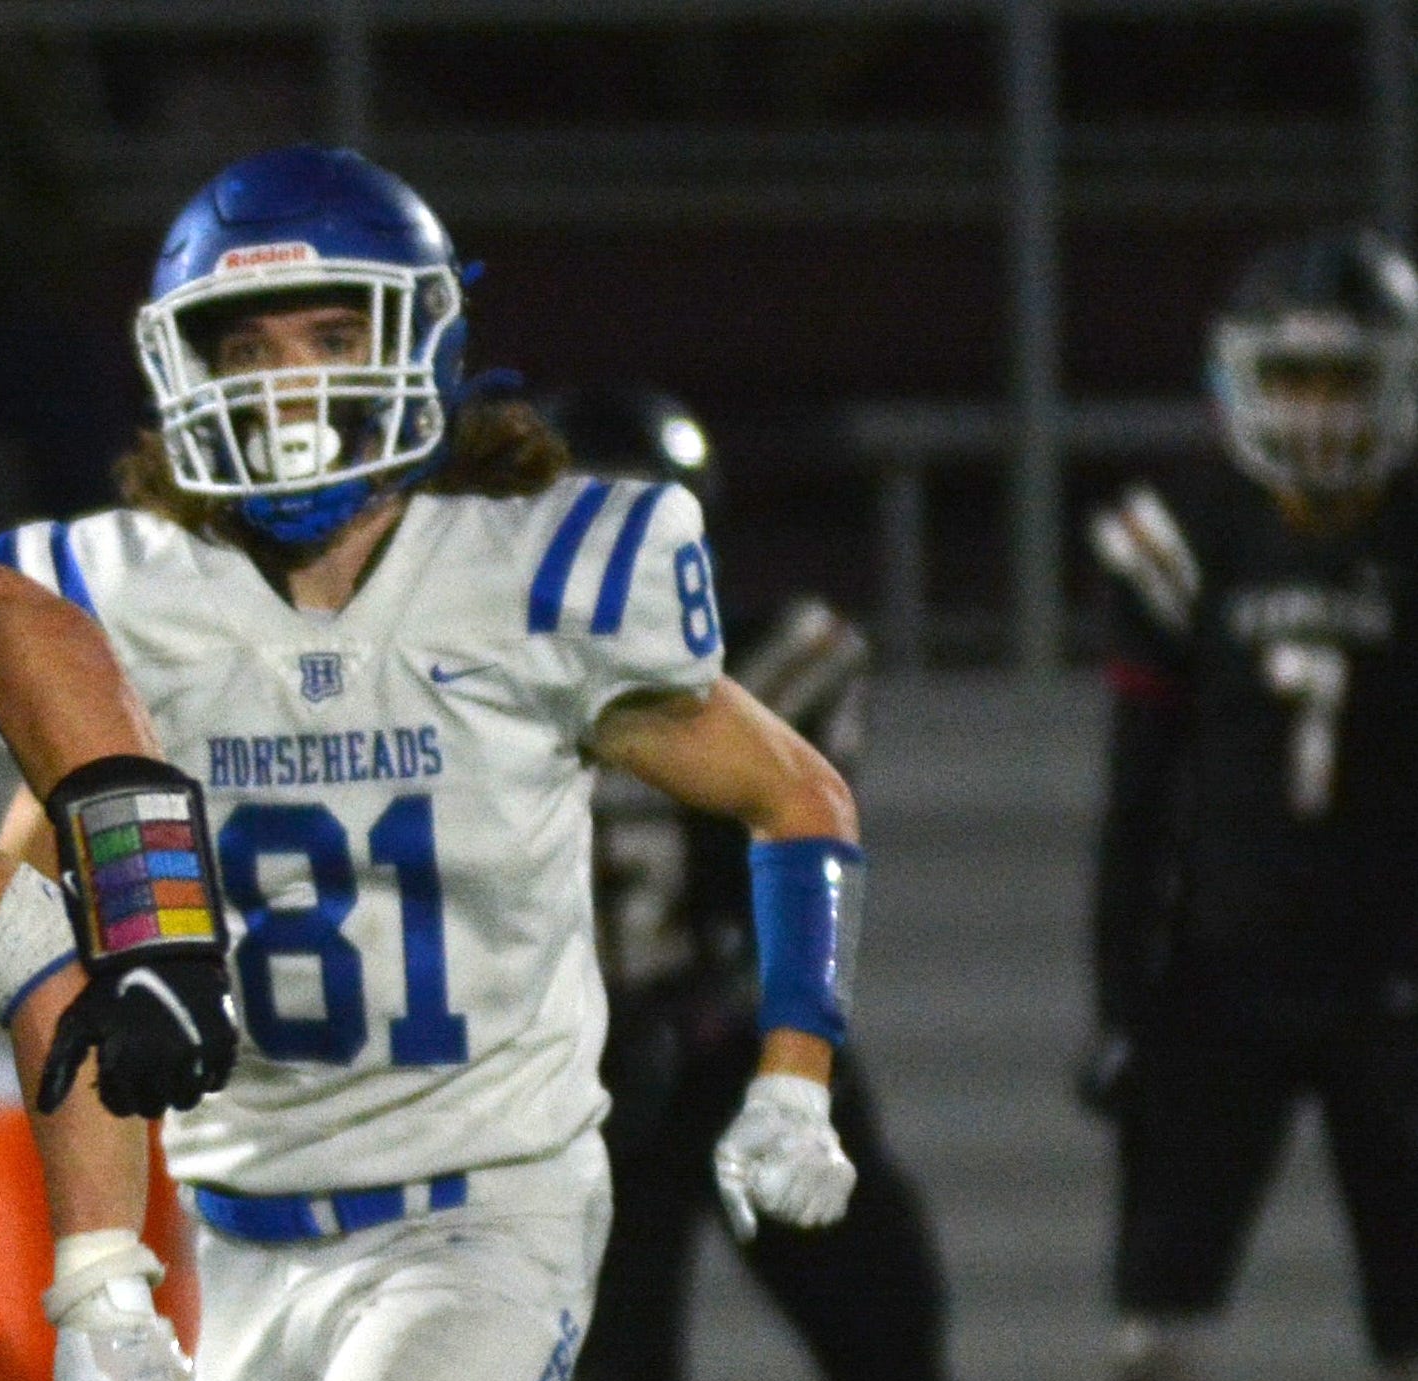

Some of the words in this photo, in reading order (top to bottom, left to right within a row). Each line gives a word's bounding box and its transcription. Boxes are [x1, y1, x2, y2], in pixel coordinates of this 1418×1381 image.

[225, 245, 307, 269] Riddell
[673, 538, 719, 659] 8
[207, 724, 444, 787] HORSEHEADS
[218, 793, 470, 1066] 81
